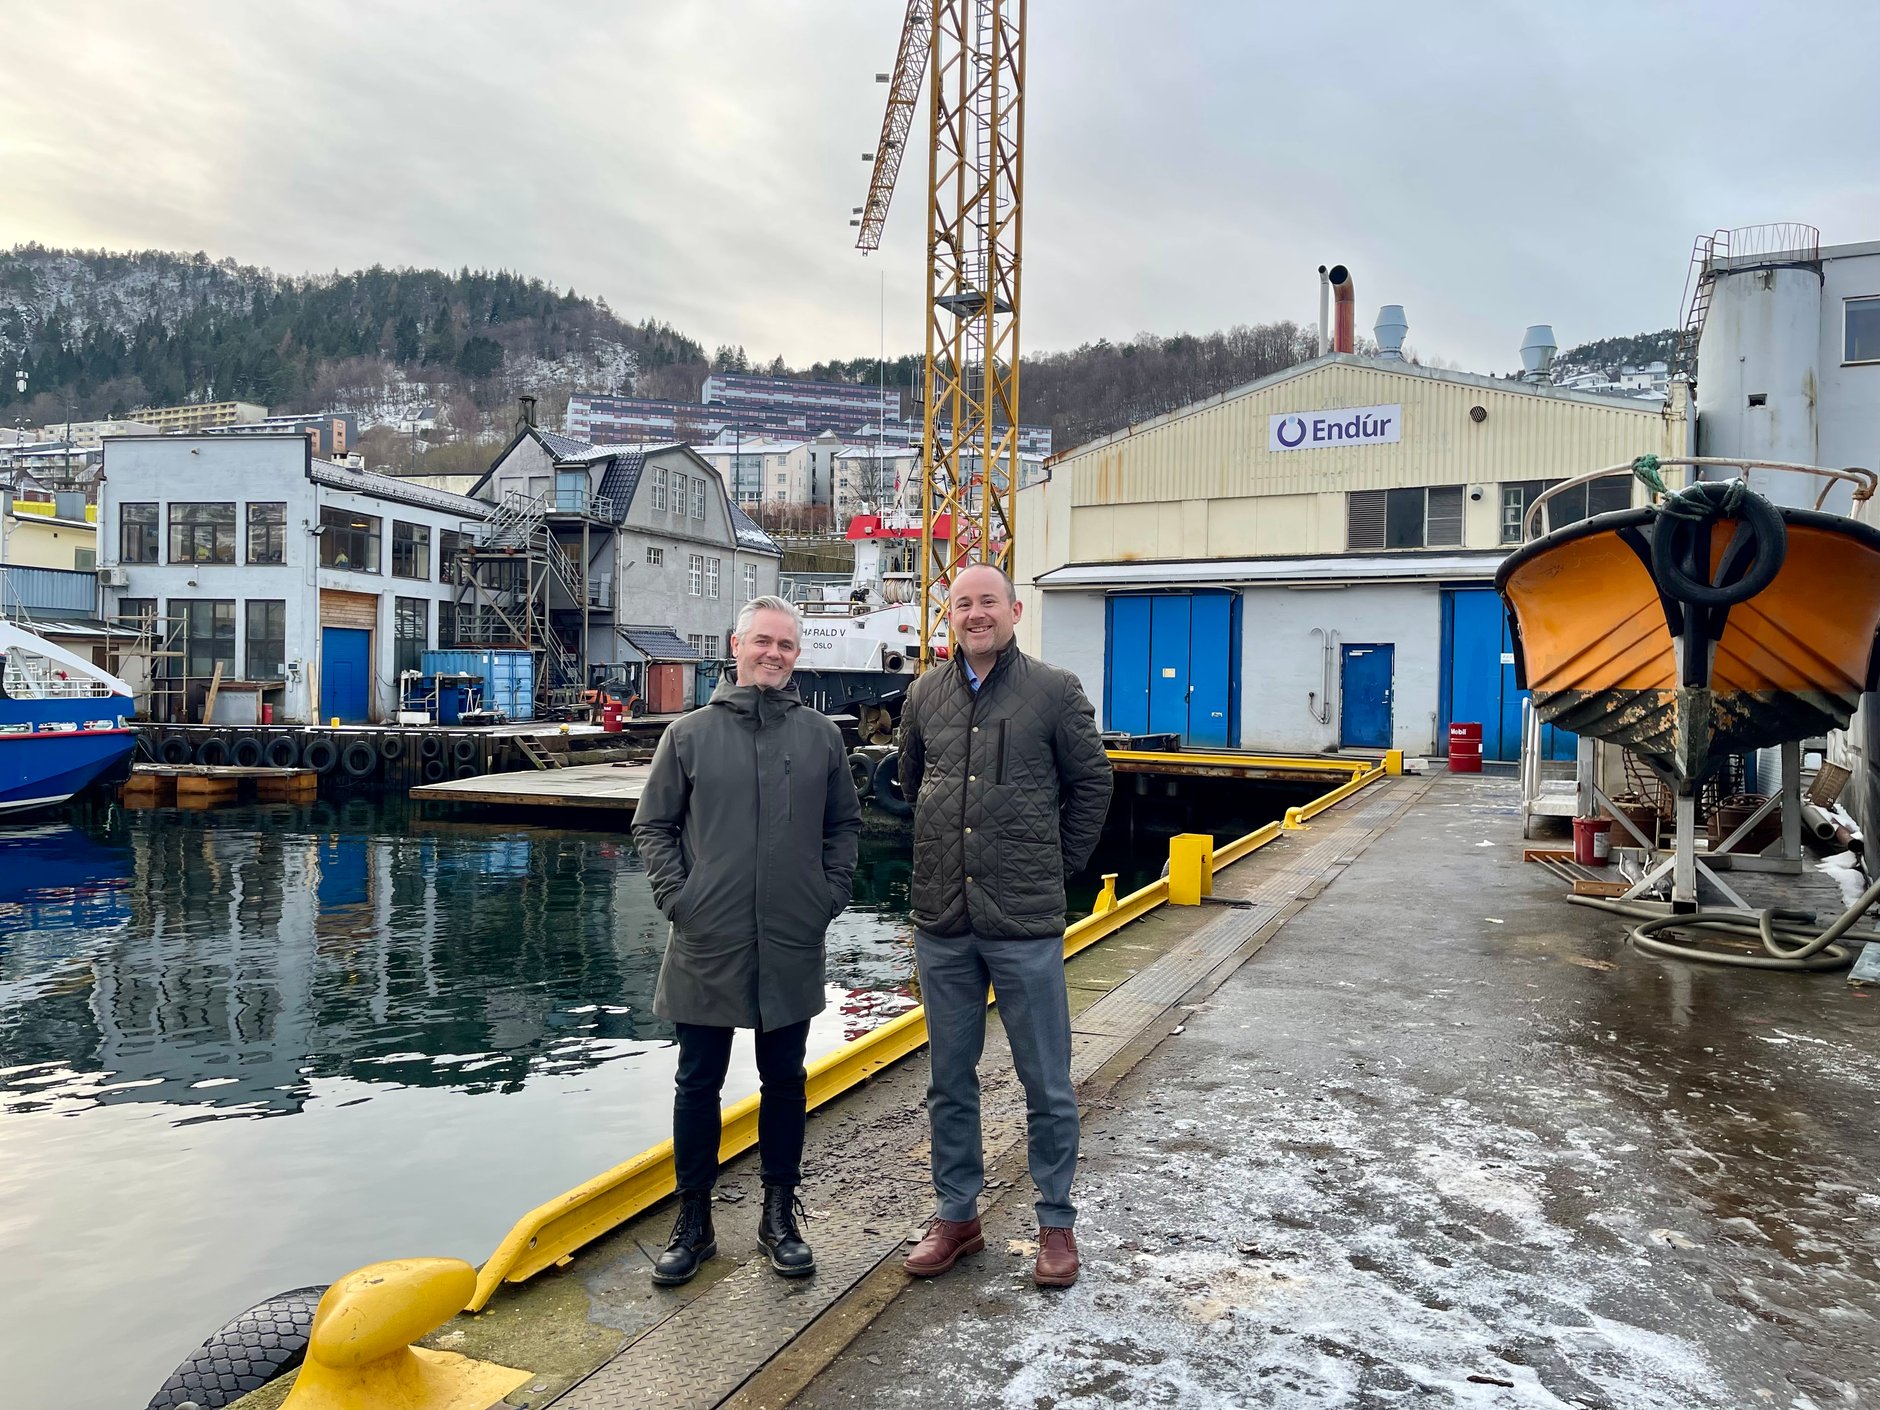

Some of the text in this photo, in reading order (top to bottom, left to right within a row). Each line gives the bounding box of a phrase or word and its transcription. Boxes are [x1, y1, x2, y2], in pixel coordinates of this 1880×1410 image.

[1313, 414, 1391, 441] Endúr
[802, 628, 847, 637] HARALD V
[813, 642, 833, 650] OSLO
